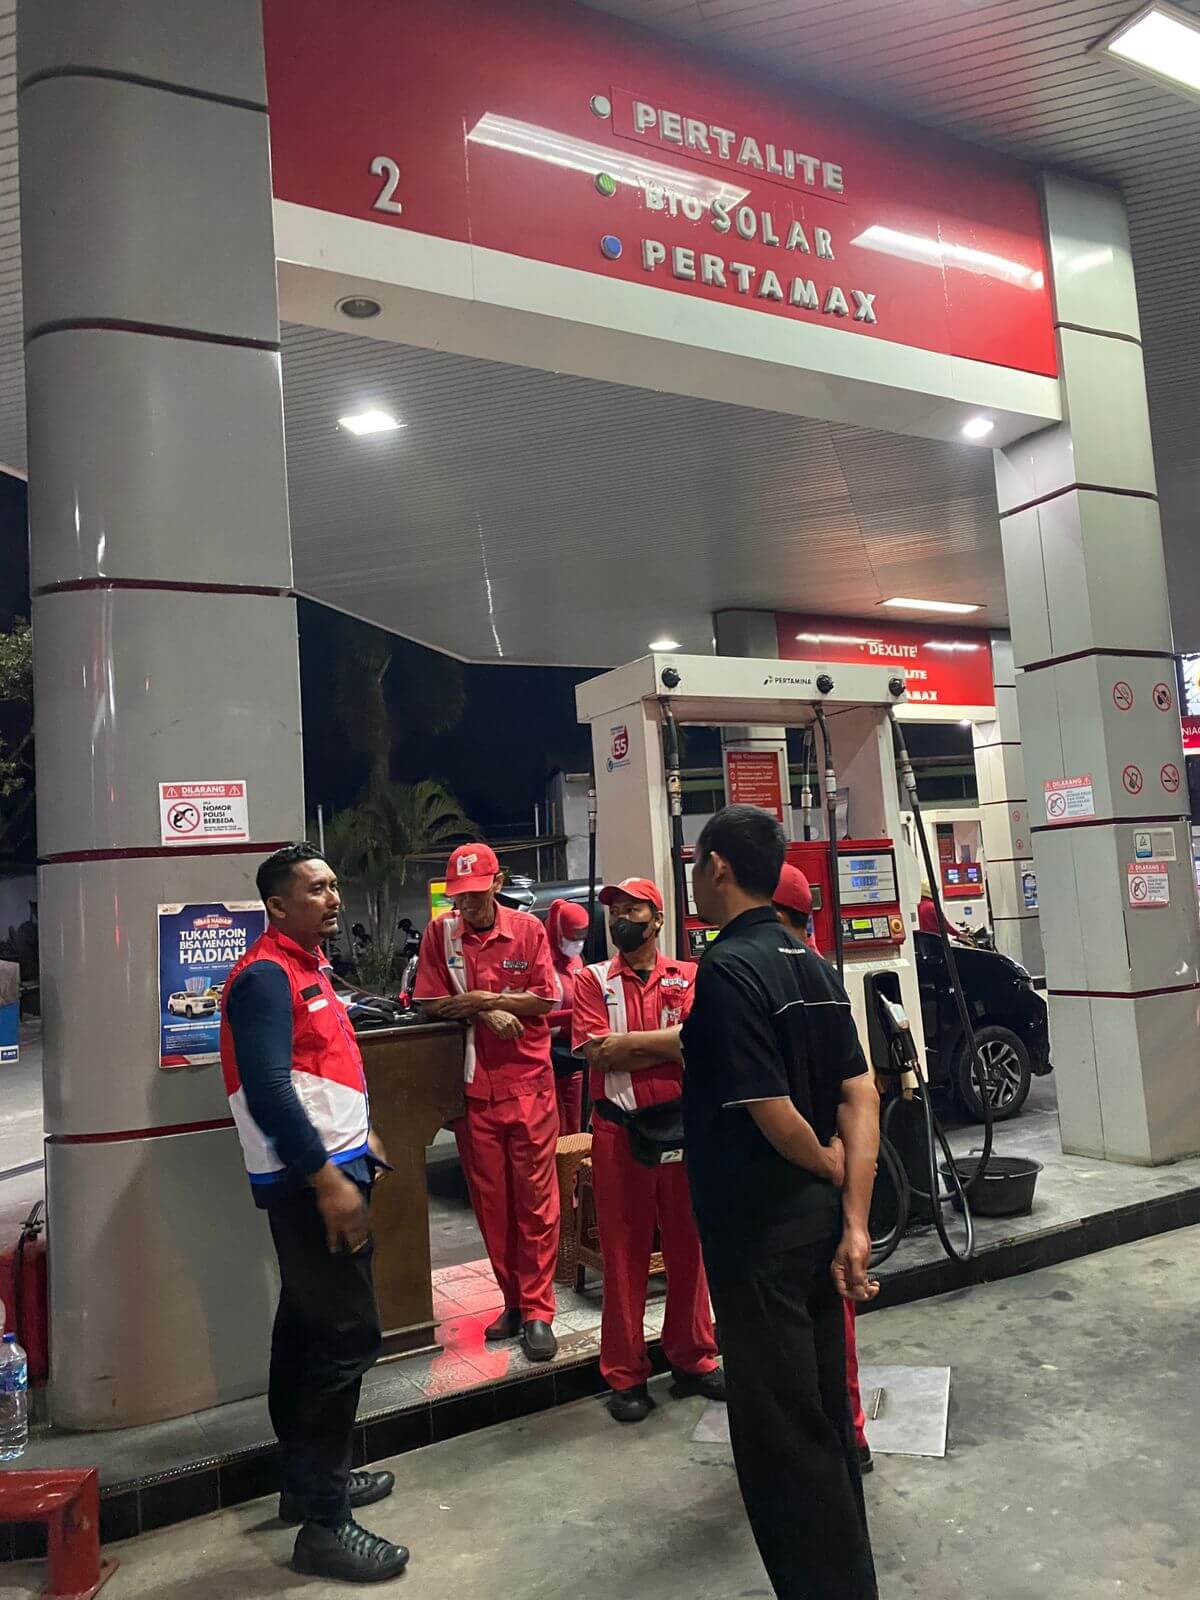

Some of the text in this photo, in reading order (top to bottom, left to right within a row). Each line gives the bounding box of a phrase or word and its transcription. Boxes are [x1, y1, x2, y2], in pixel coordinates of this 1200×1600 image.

[633, 100, 845, 194] PERTALITE
[369, 156, 402, 215] 2
[641, 238, 878, 324] PERTAMAX
[869, 643, 918, 658] DEXLITE
[774, 677, 812, 685] PERTAMINA
[181, 785, 226, 794] DILARANG
[203, 804, 232, 812] NOMOR
[203, 817, 235, 825] BERBEDA
[179, 927, 247, 941] TUKAR POIN
[179, 937, 247, 950] BISA MENANG
[179, 946, 247, 965] HADIAH
